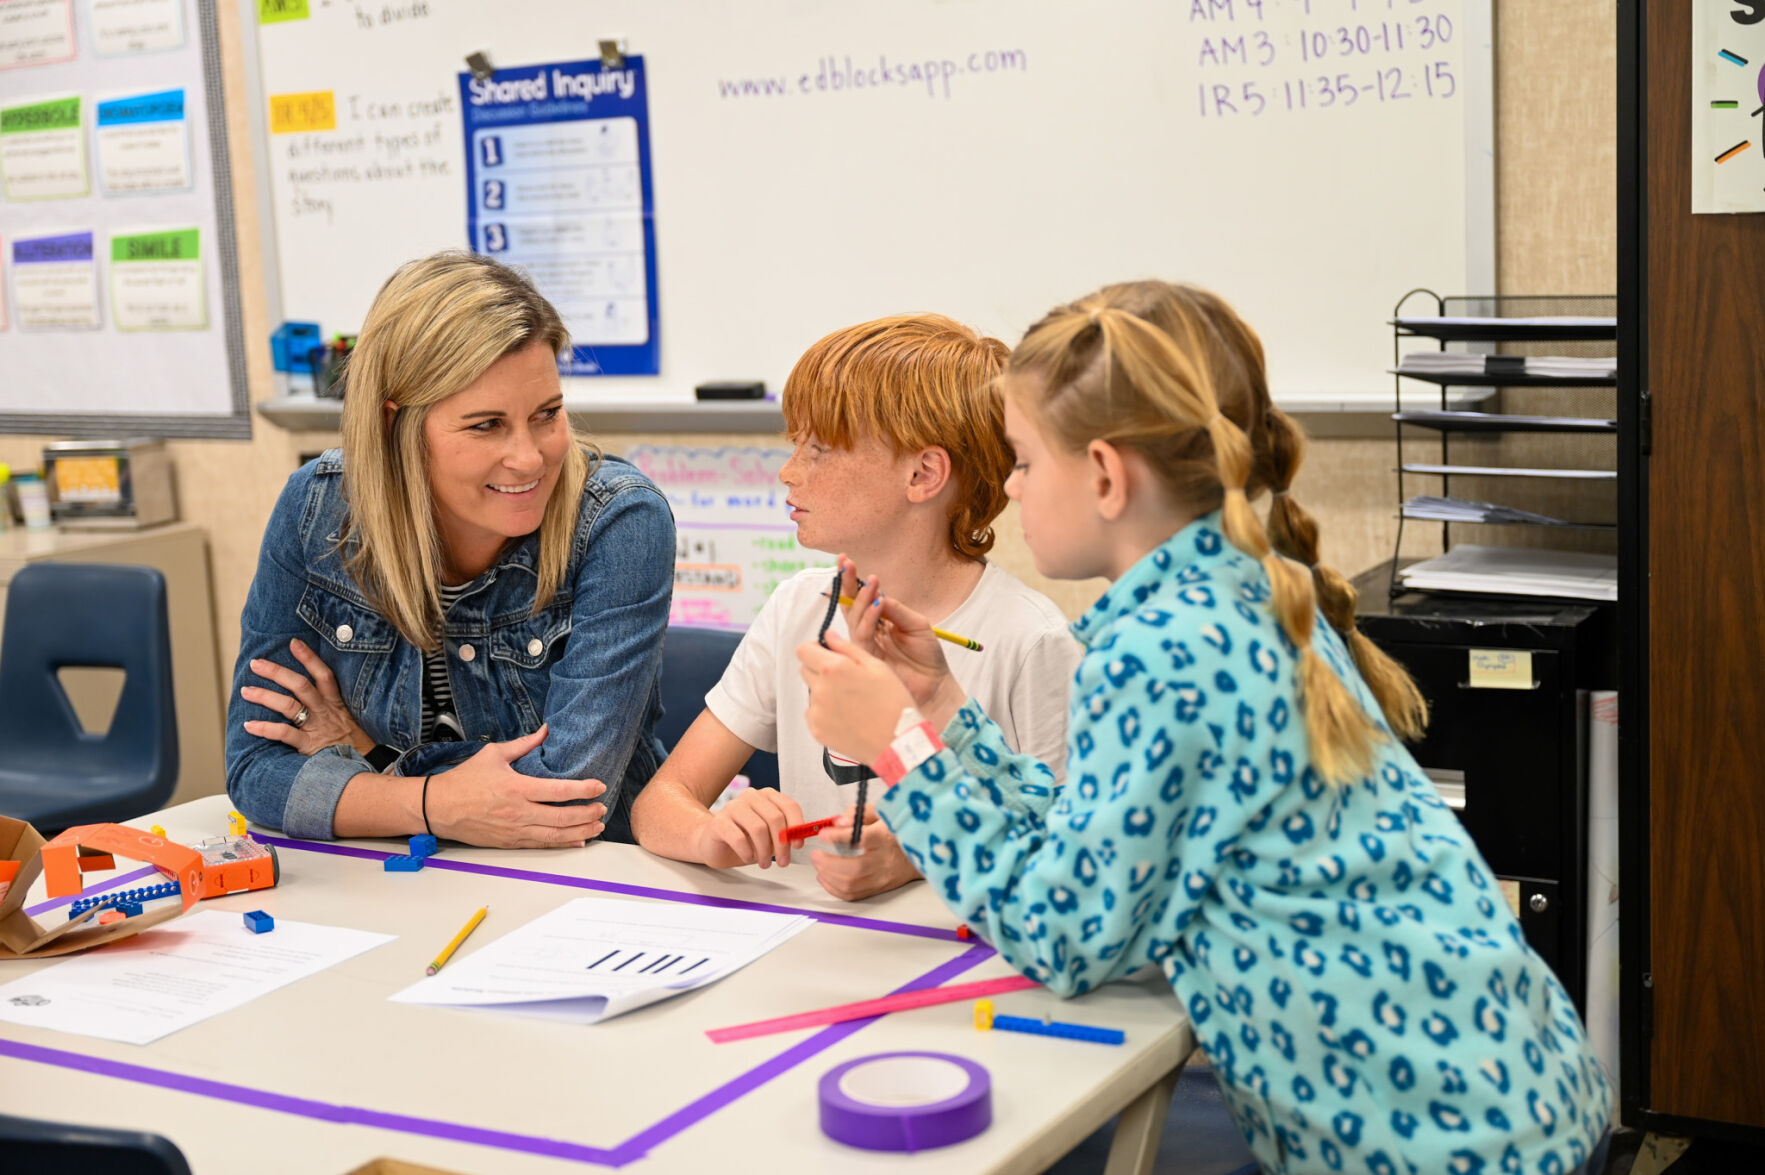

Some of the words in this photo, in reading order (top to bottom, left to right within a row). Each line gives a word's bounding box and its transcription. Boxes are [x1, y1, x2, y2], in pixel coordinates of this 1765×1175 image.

[469, 71, 547, 105] Shared
[552, 67, 635, 102] Inquiry
[717, 48, 1028, 99] www.edblocksapp.com
[484, 137, 498, 165] 1
[485, 180, 503, 208] 2
[127, 237, 183, 259] SIMILE
[487, 223, 505, 250] 3
